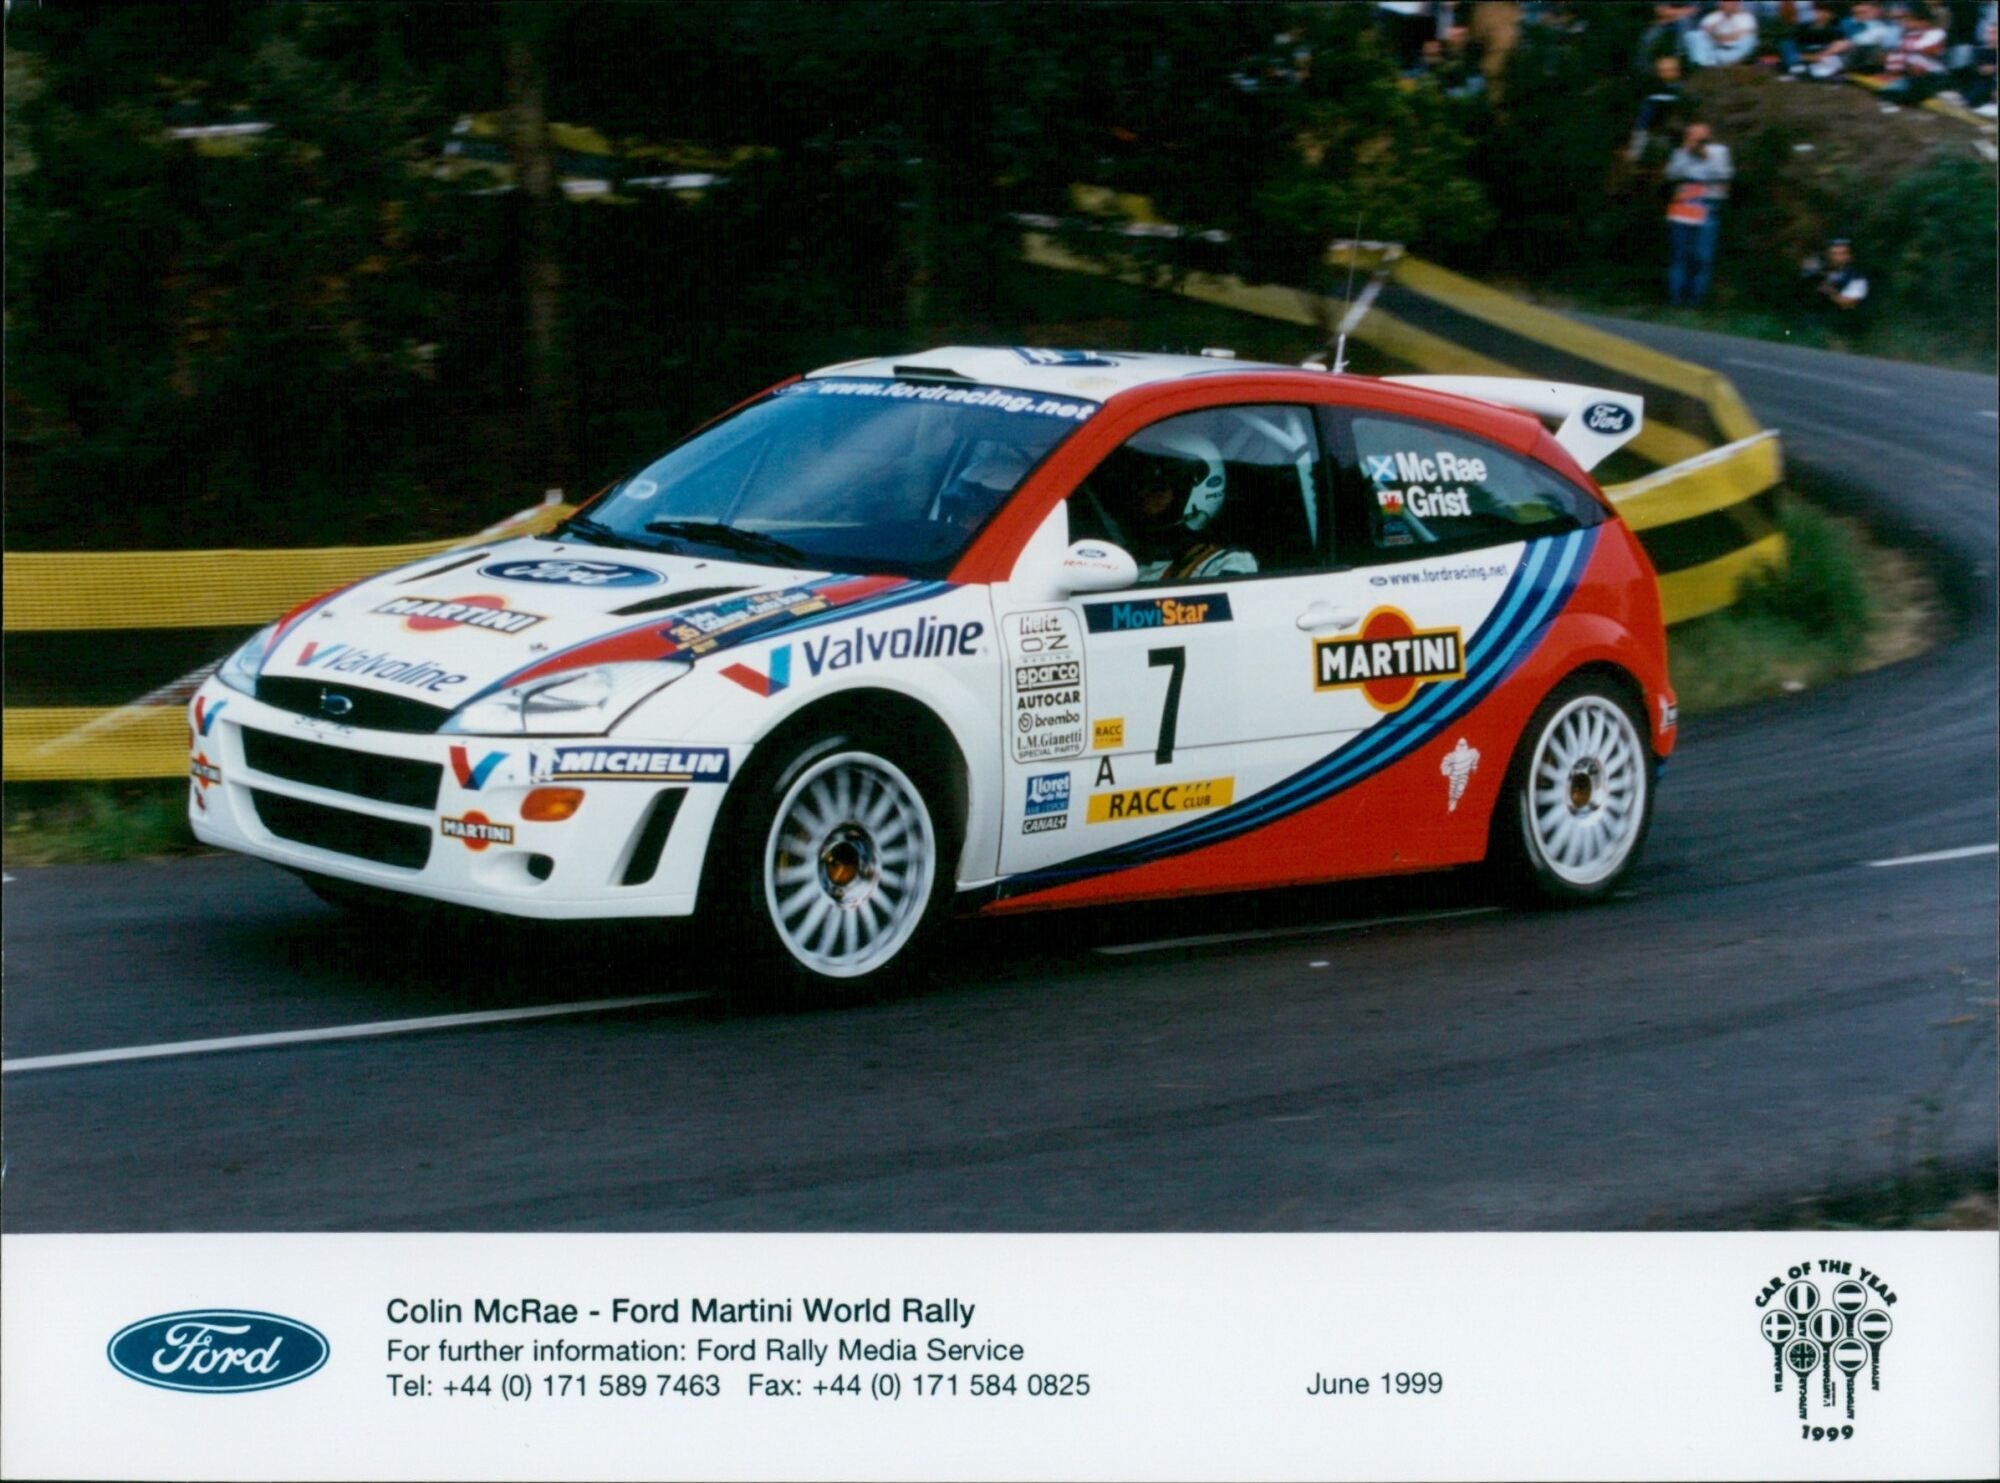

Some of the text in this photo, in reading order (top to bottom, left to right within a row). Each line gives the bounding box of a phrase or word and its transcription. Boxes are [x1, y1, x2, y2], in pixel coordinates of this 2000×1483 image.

[818, 382, 1096, 421] www.fordracing.net
[1590, 404, 1626, 430] Ford
[1407, 487, 1472, 517] Grist
[503, 560, 633, 585] Ford
[379, 598, 536, 632] MARTINI
[1112, 599, 1208, 630] MoviStar
[803, 615, 984, 677] Valvoline
[1321, 636, 1456, 681] MARTINI
[322, 647, 468, 692] Valvoline
[1017, 662, 1079, 688] sparco
[1017, 690, 1081, 711] AUTOCAR
[1147, 645, 1186, 766] 7
[1035, 710, 1080, 728] brembo
[1095, 725, 1122, 736] RACC
[560, 752, 725, 774] MICHELIN
[1054, 744, 1081, 755] PARTS
[1094, 754, 1116, 787] A
[1109, 786, 1211, 819] RACC CLUB
[443, 820, 511, 842] MARTINI
